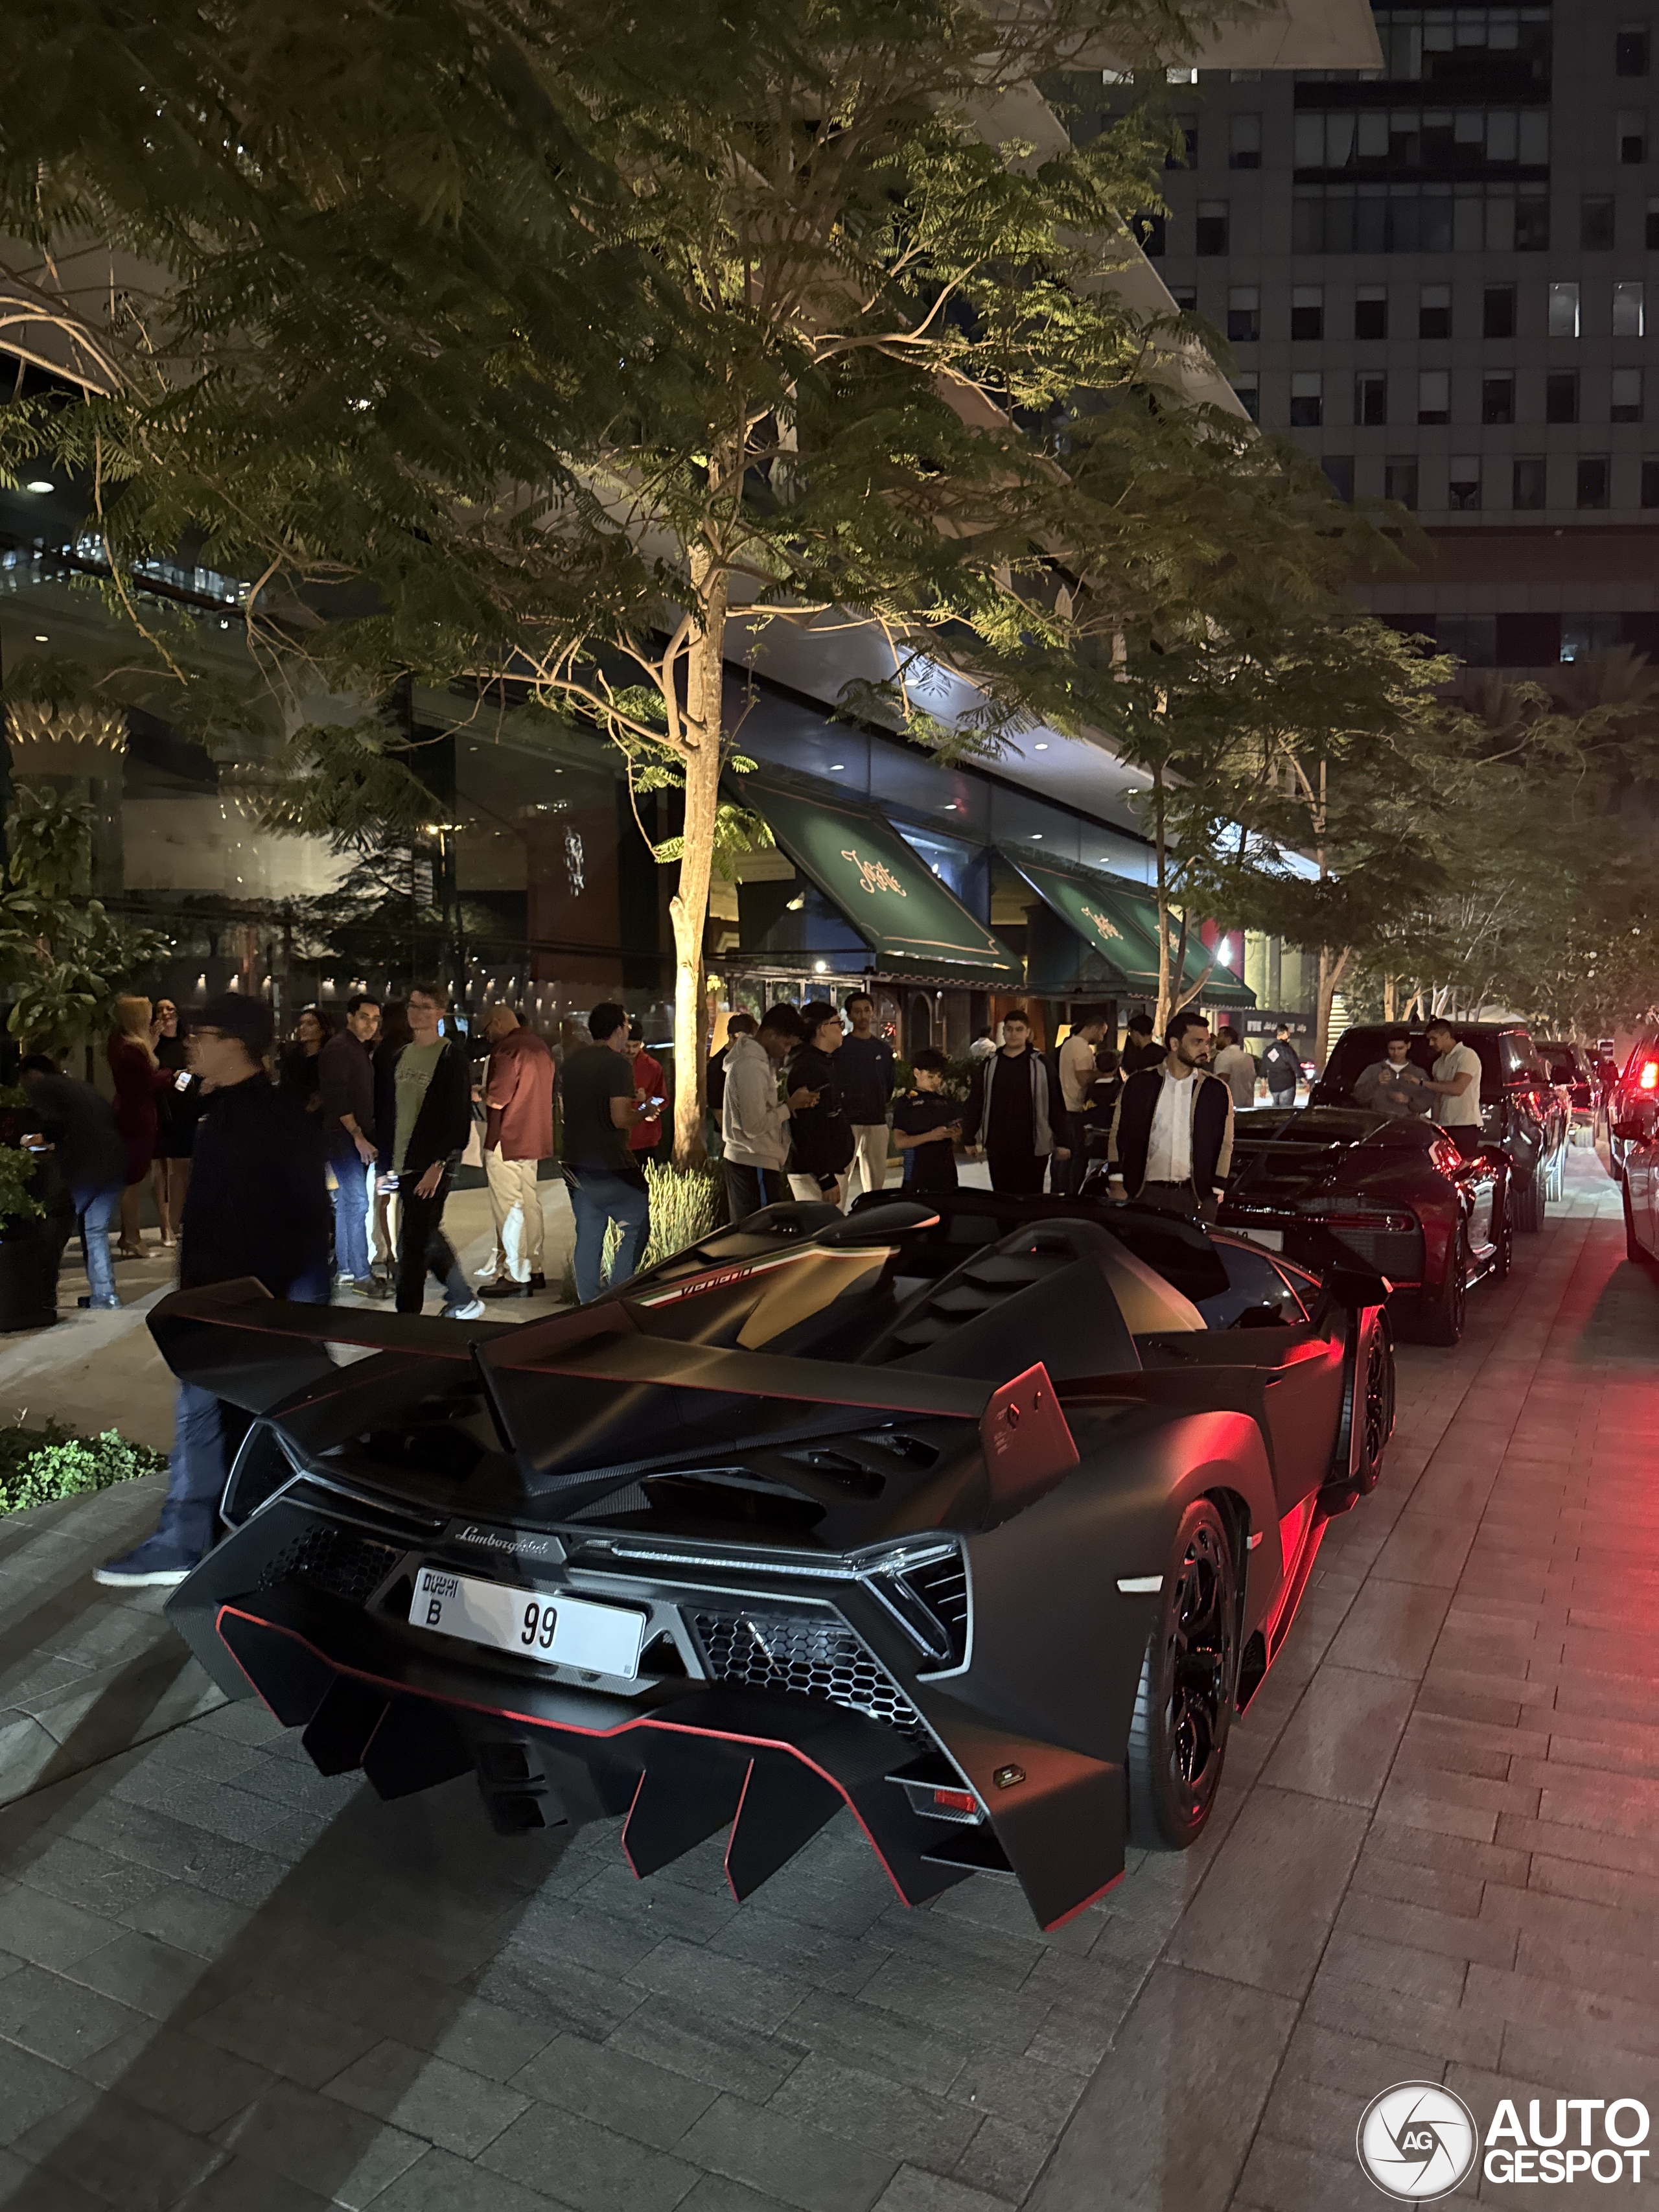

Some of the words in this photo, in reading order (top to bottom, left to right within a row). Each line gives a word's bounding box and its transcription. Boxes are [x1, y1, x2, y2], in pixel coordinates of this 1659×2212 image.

[455, 1526, 550, 1555] Lamborghini
[426, 1599, 442, 1625] B
[521, 1602, 558, 1649] 99
